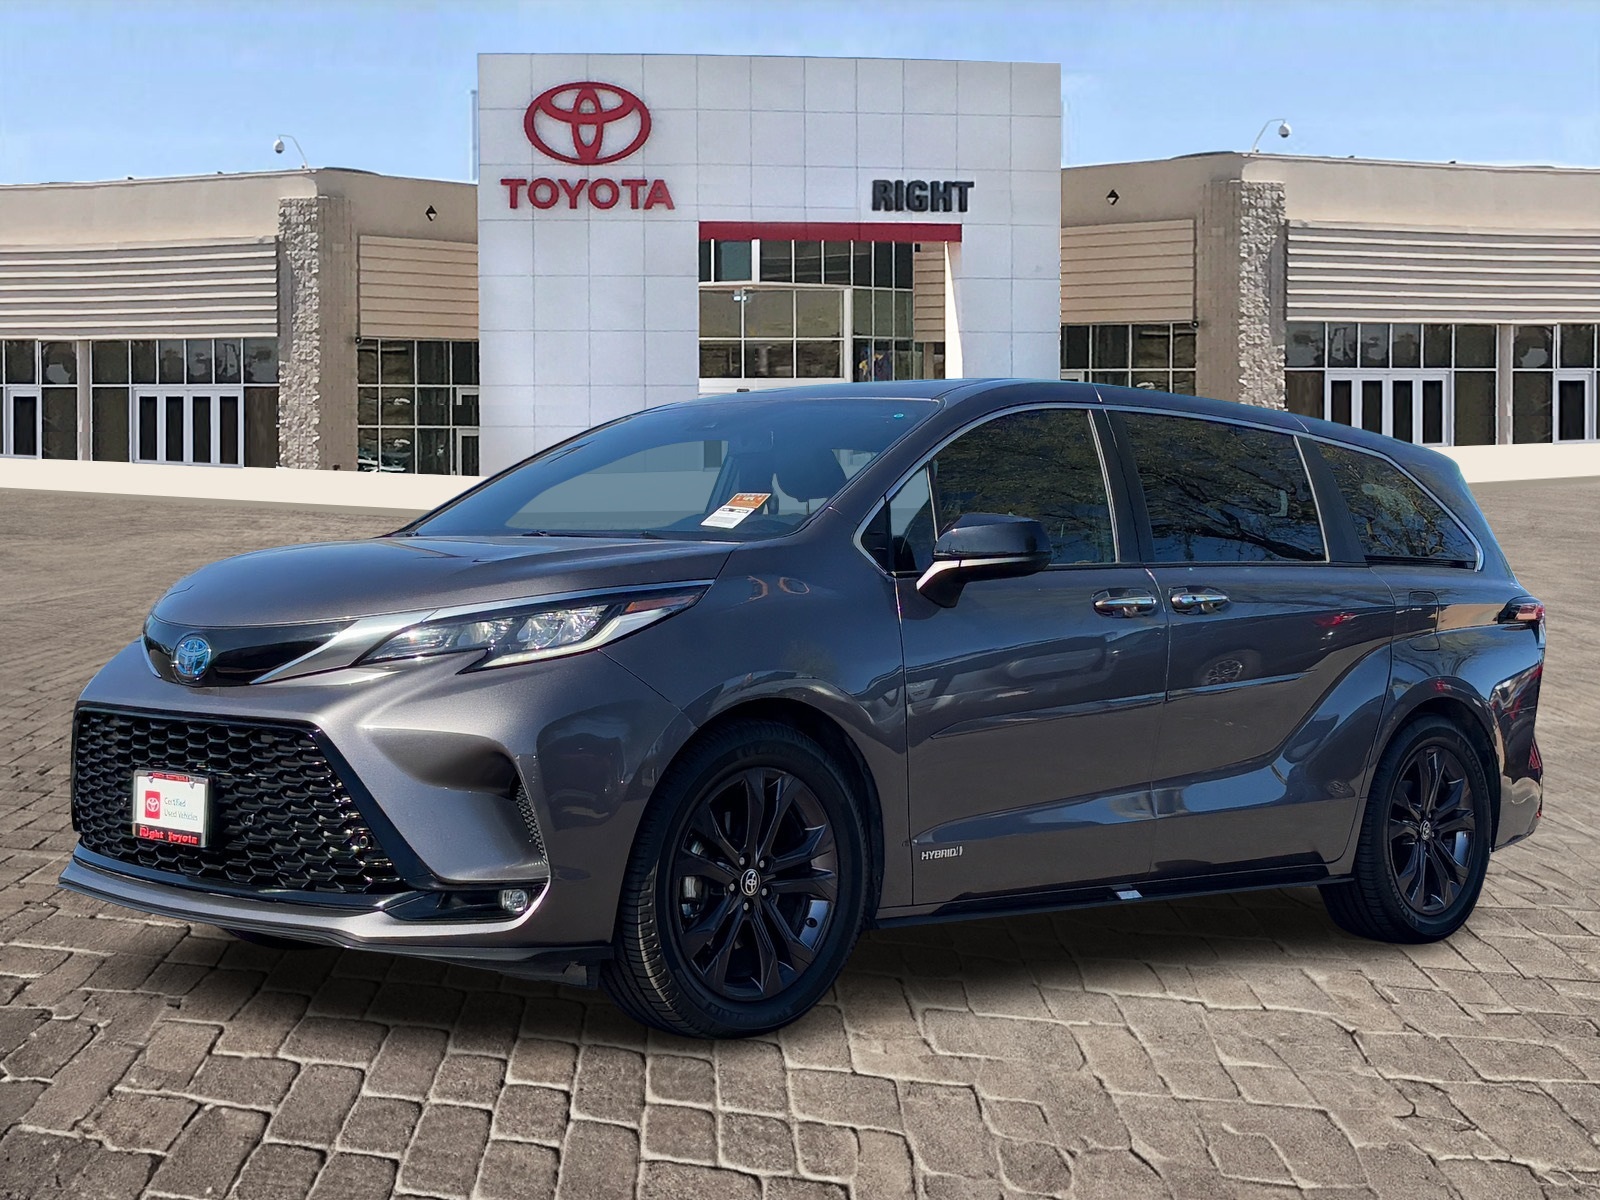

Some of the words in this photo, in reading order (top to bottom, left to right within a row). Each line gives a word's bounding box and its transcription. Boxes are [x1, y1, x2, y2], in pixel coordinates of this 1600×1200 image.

[501, 178, 675, 210] TOYOTA
[871, 179, 975, 213] RIGHT
[164, 797, 186, 807] Certified
[168, 831, 198, 844] Toyota
[921, 847, 959, 860] HYBRID
